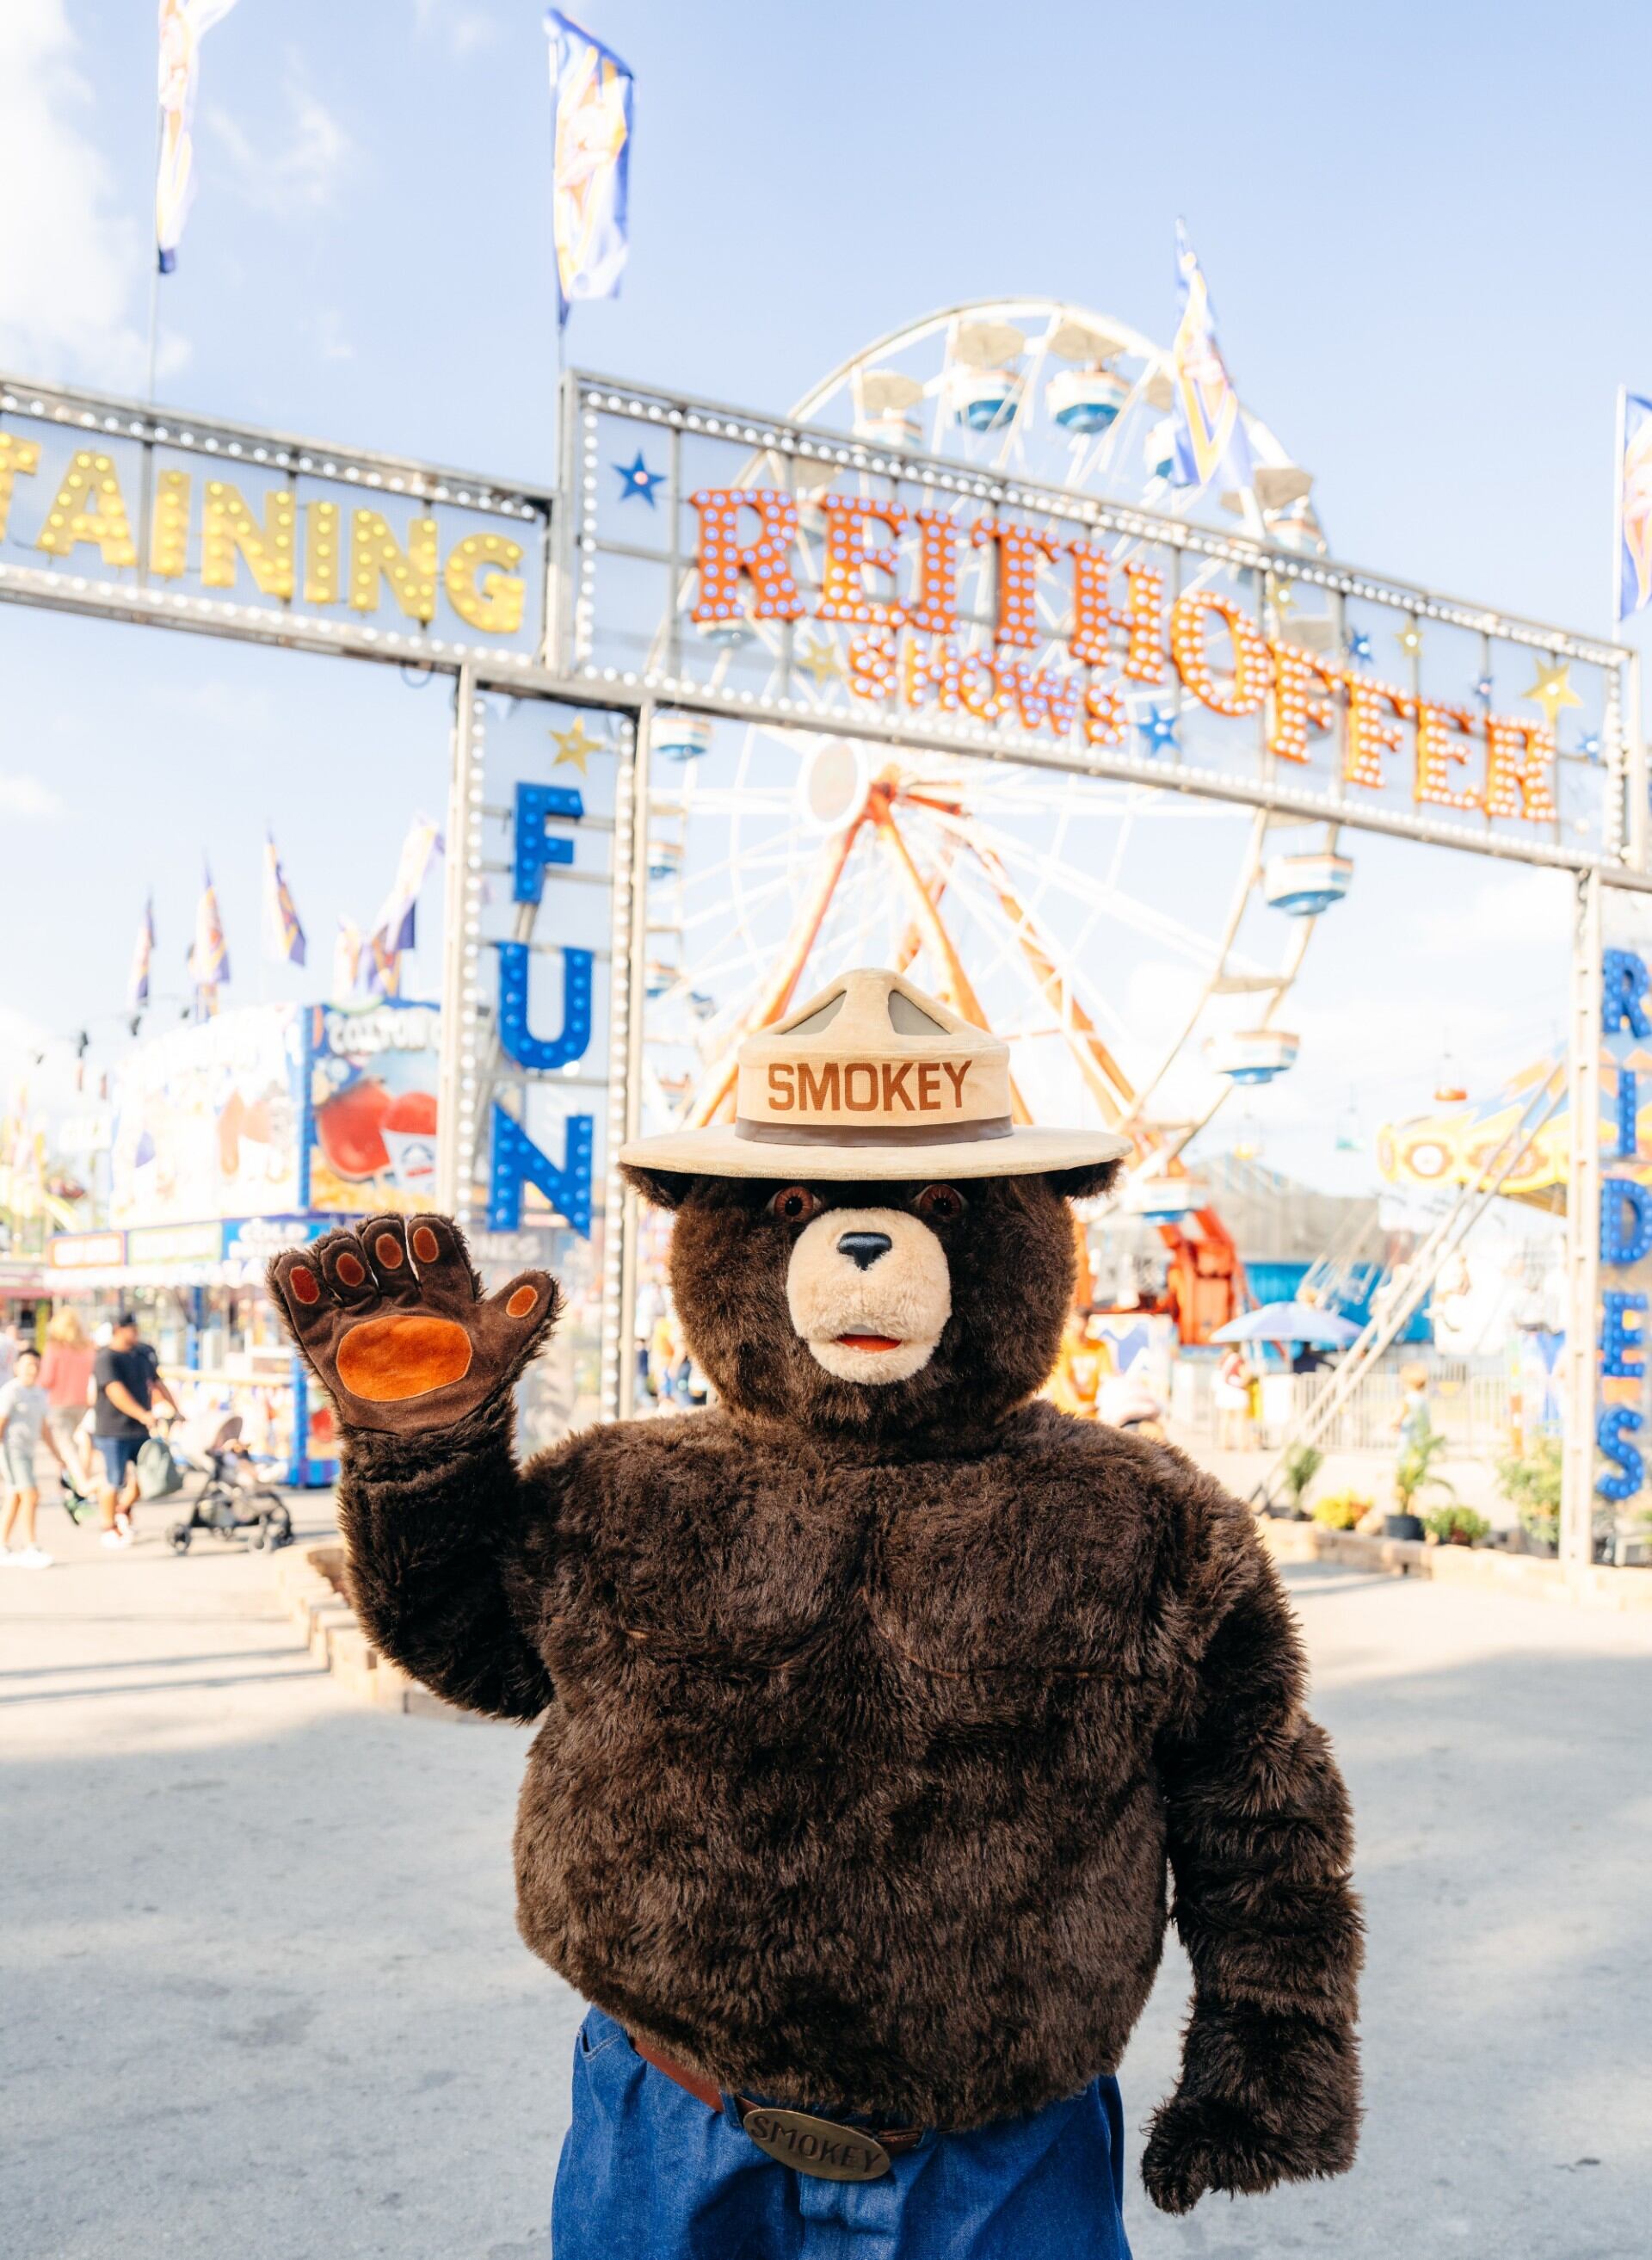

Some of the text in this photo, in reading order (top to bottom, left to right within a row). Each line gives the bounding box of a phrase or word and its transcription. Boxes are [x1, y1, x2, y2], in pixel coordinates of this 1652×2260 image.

[689, 488, 1559, 823] REITHOFFER
[849, 634, 1130, 746] SHOWS
[486, 781, 595, 1240] FUN
[768, 1059, 972, 1112] SMOKEY
[1596, 948, 1652, 1500] RIDES
[750, 2115, 881, 2173] SMOKEY
